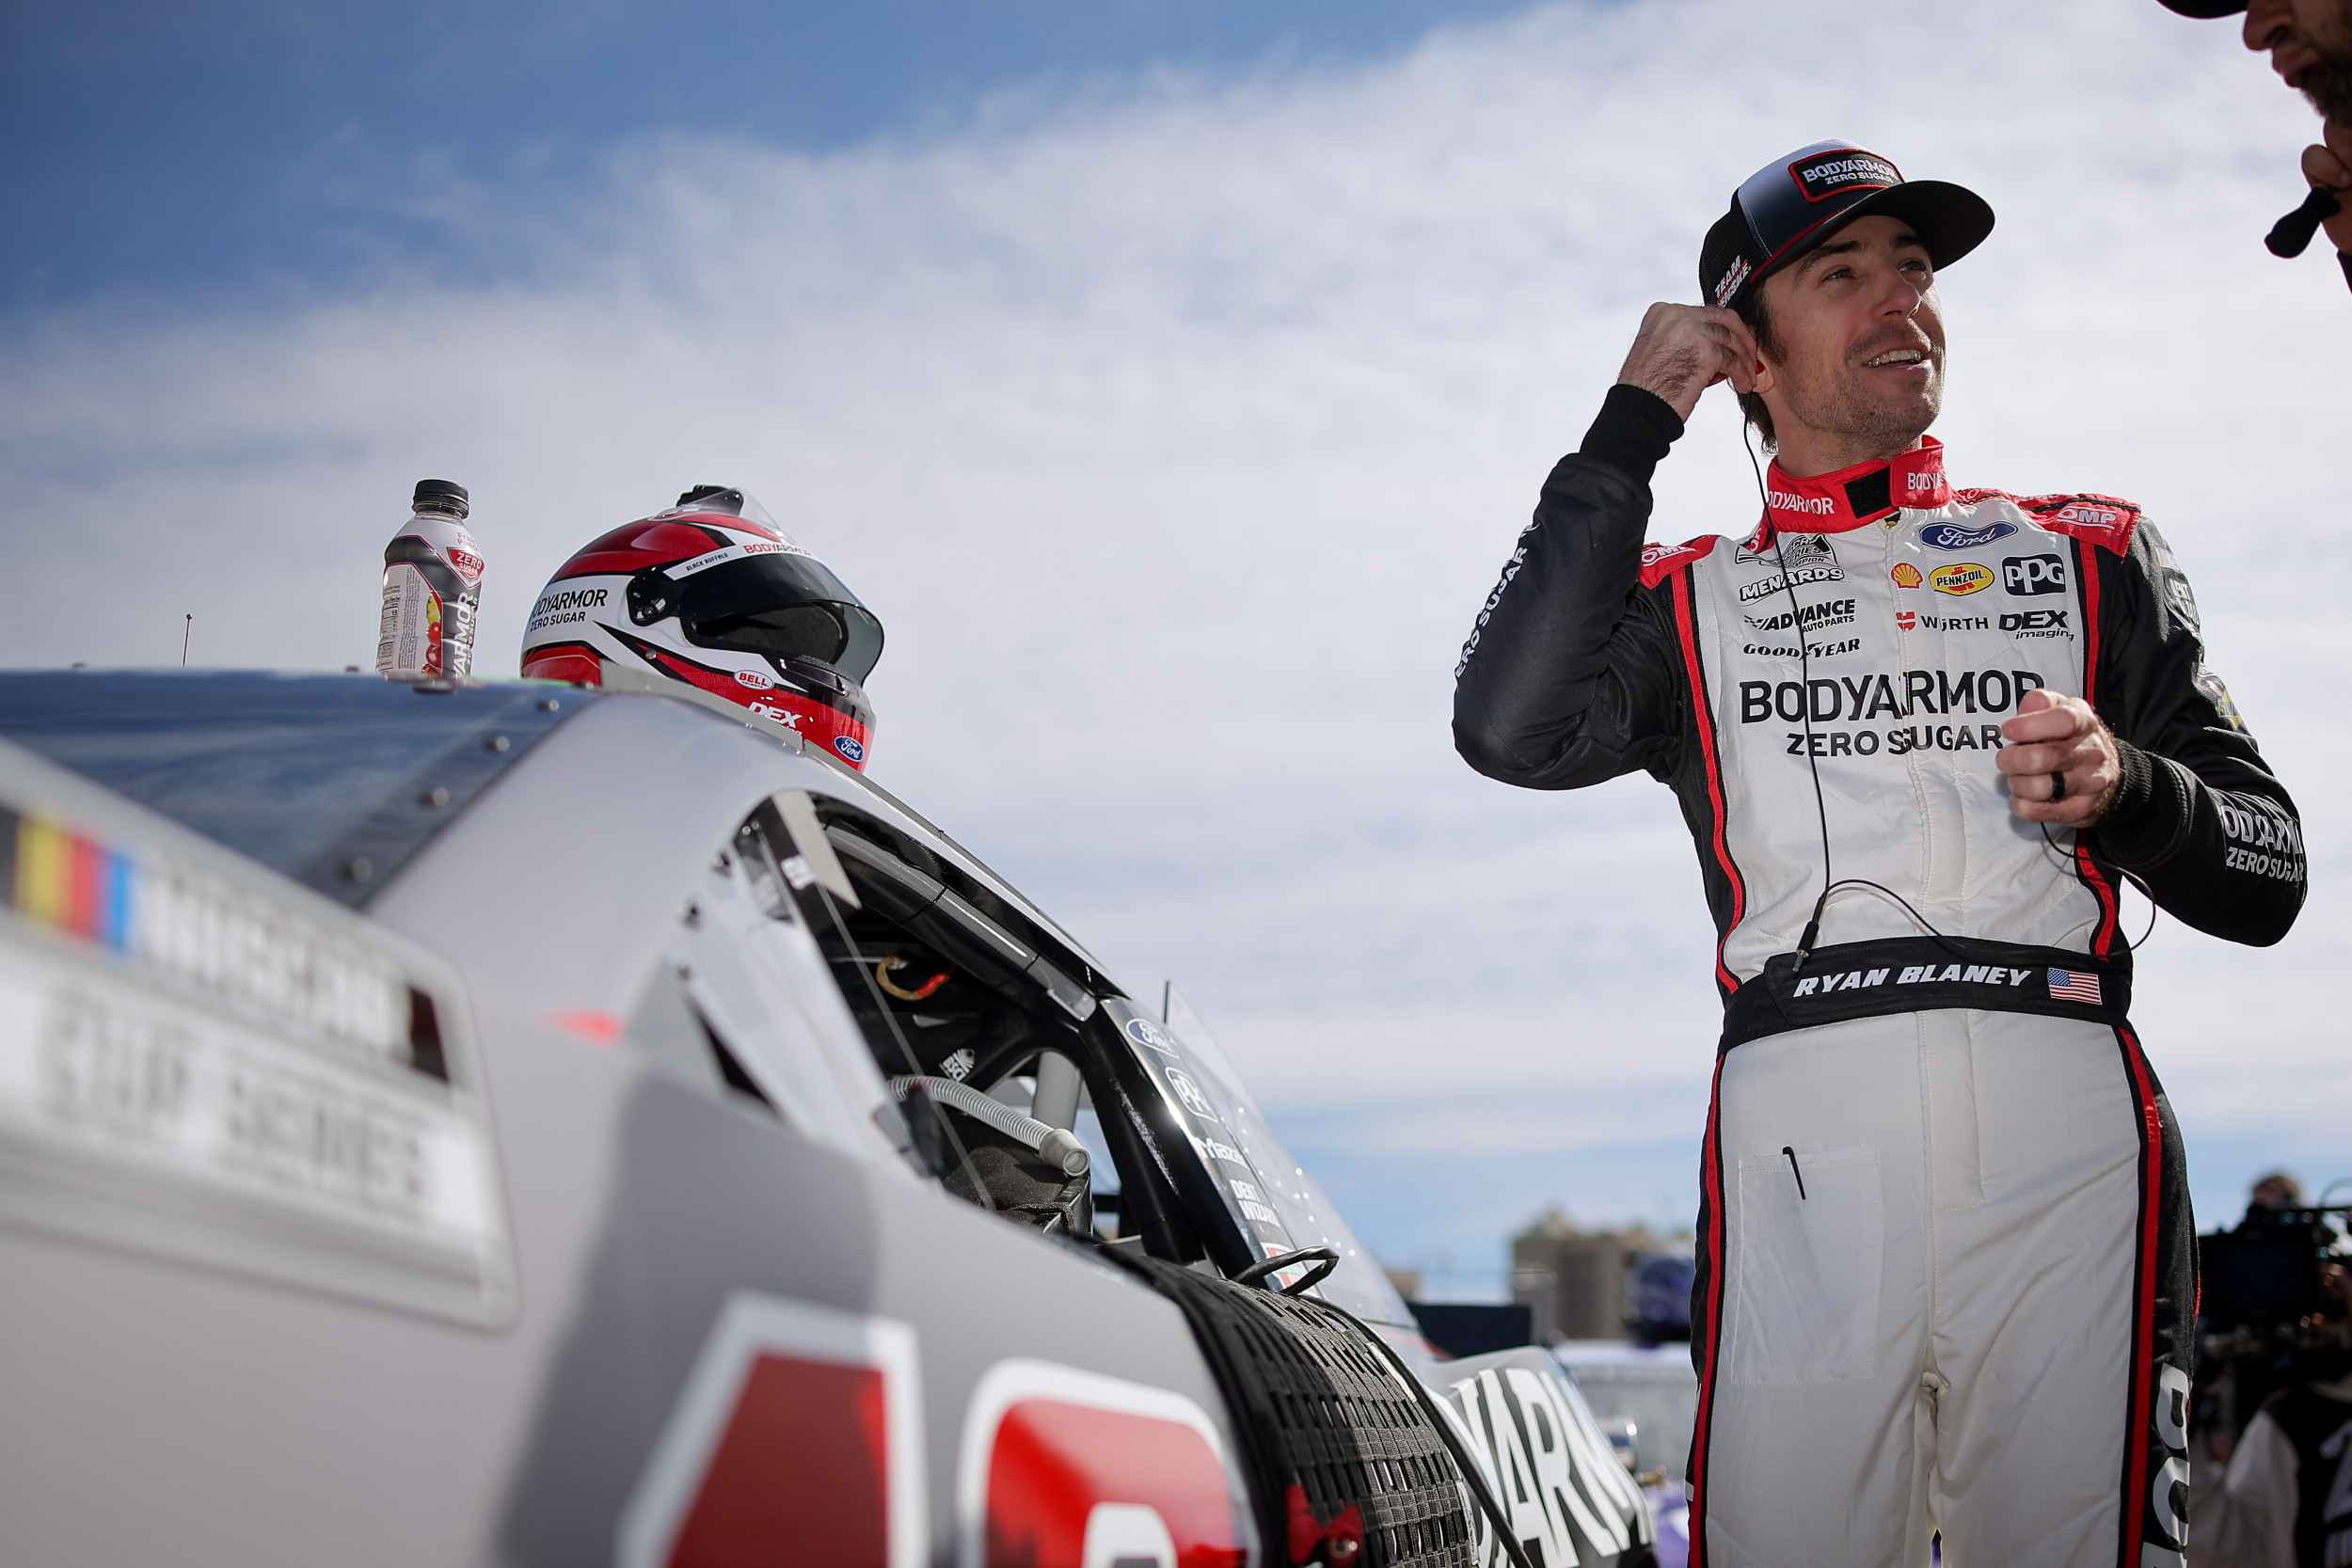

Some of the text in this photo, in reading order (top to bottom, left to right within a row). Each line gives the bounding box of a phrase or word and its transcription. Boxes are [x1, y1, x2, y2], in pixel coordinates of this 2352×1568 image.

[1803, 159, 1900, 182] BODYARMOR
[1825, 171, 1895, 185] ZERO SUGAR
[1714, 254, 1740, 299] TEAM
[2058, 508, 2118, 524] OMP
[1936, 526, 1996, 546] Ford
[455, 551, 483, 571] ZERO
[1740, 567, 1845, 602] MENARDS
[2004, 558, 2066, 594] PPG
[530, 611, 586, 633] ZERO SUGAR
[1763, 599, 1856, 631] ADVANCE
[1802, 615, 1854, 633] AUTO PARTS
[1998, 610, 2069, 631] DEX
[739, 672, 769, 688] BELL
[748, 702, 803, 728] DEX
[840, 737, 861, 760] Ford
[1786, 724, 2004, 757] ZERO SUGAR
[2226, 846, 2304, 882] ZERO SUGAR
[1792, 963, 2032, 998] RYAN BLANEY
